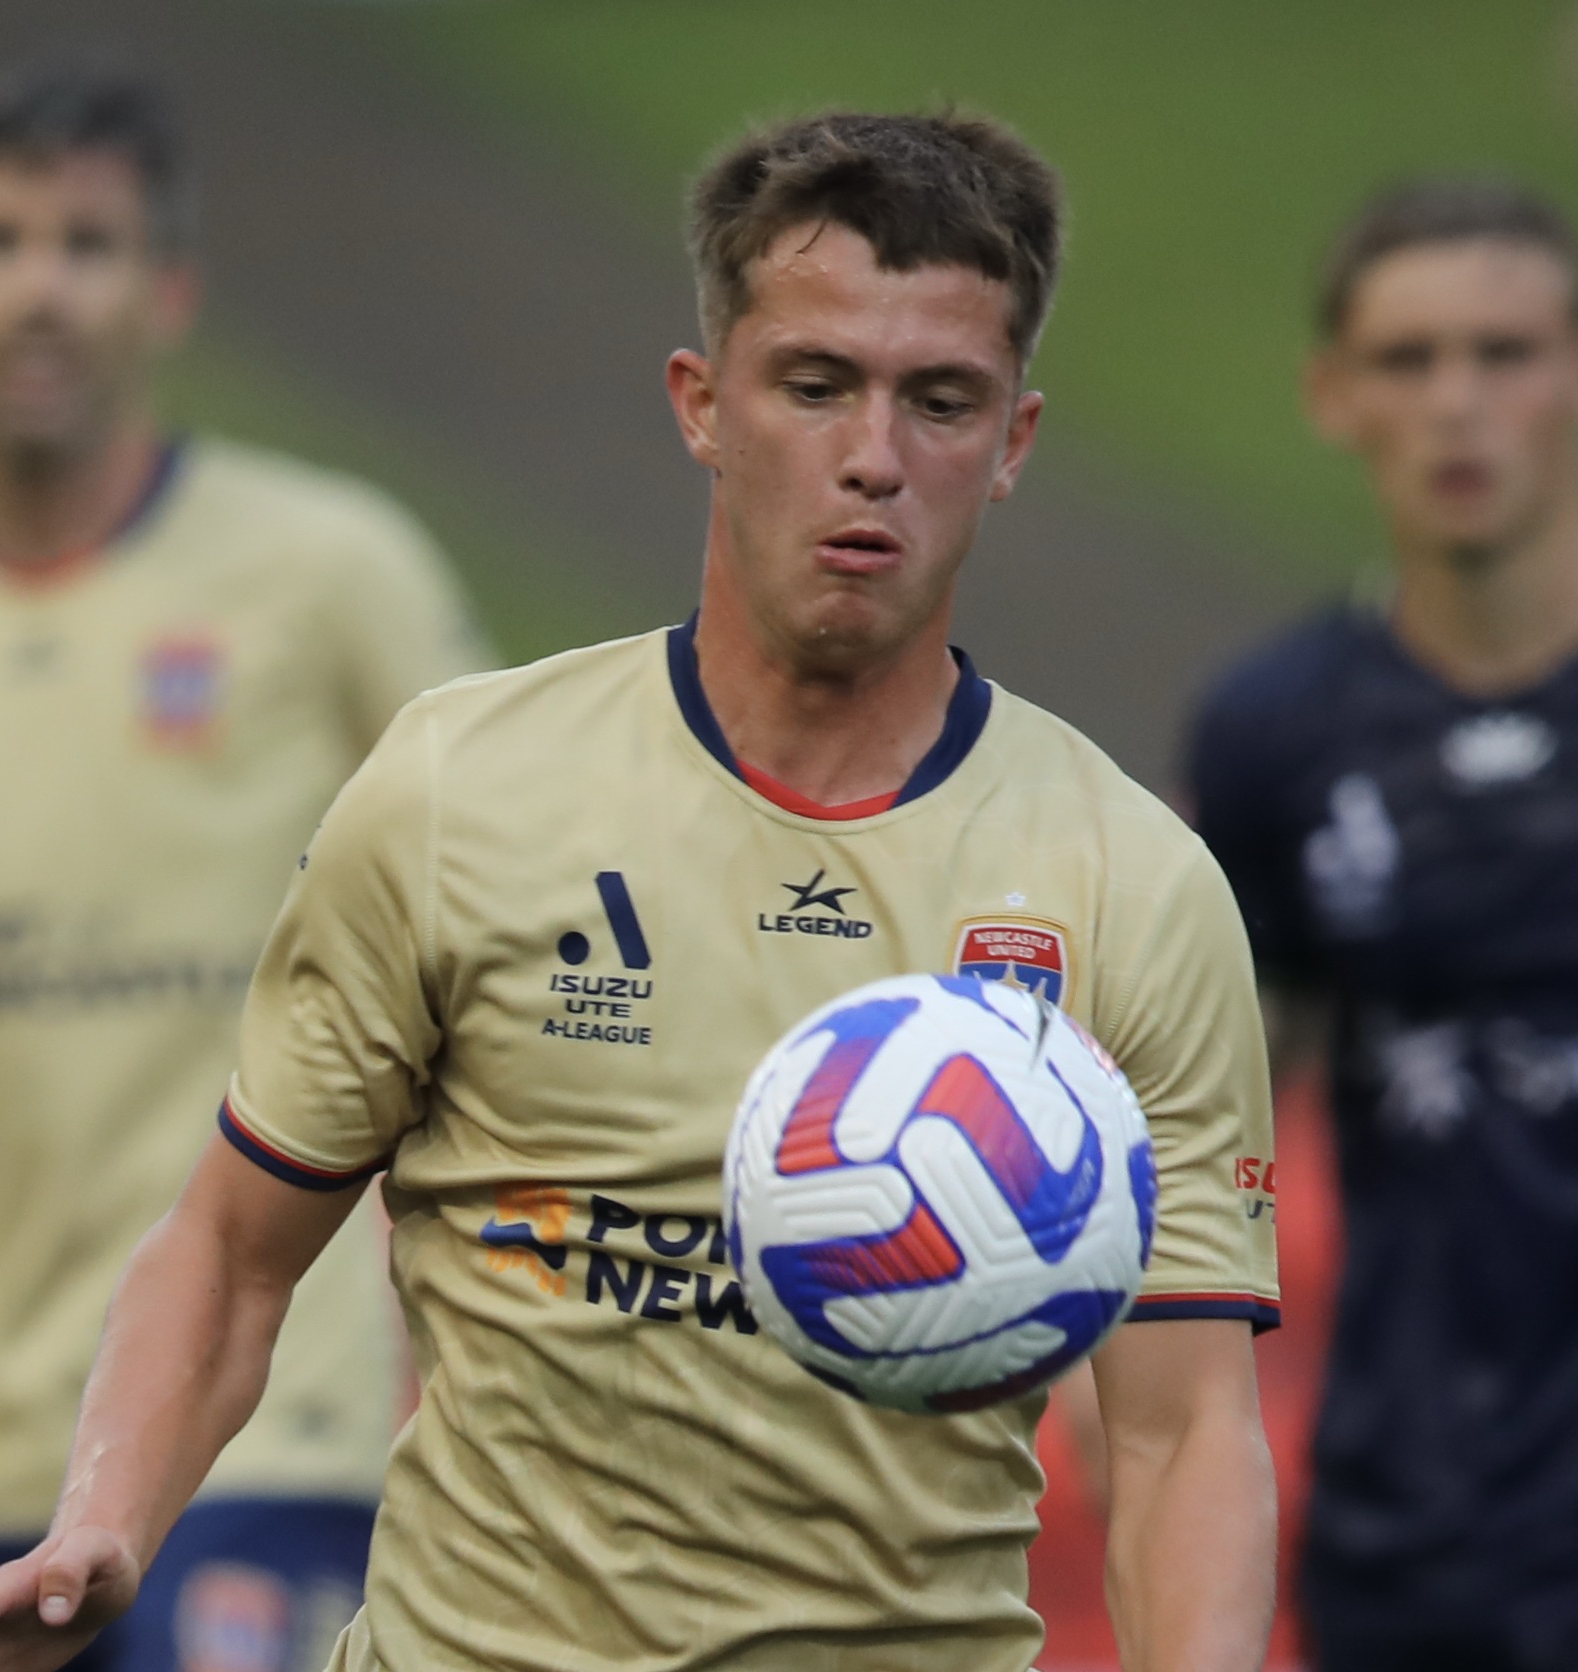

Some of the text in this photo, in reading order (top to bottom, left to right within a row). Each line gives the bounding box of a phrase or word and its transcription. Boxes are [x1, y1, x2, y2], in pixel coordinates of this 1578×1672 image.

[758, 913, 872, 939] LEGEND
[973, 931, 1054, 951] NEWCASTLE
[987, 944, 1036, 959] UNITED
[549, 974, 652, 999] ISUZU
[566, 999, 631, 1018] UTE
[542, 1018, 652, 1045] A-LEAGUE
